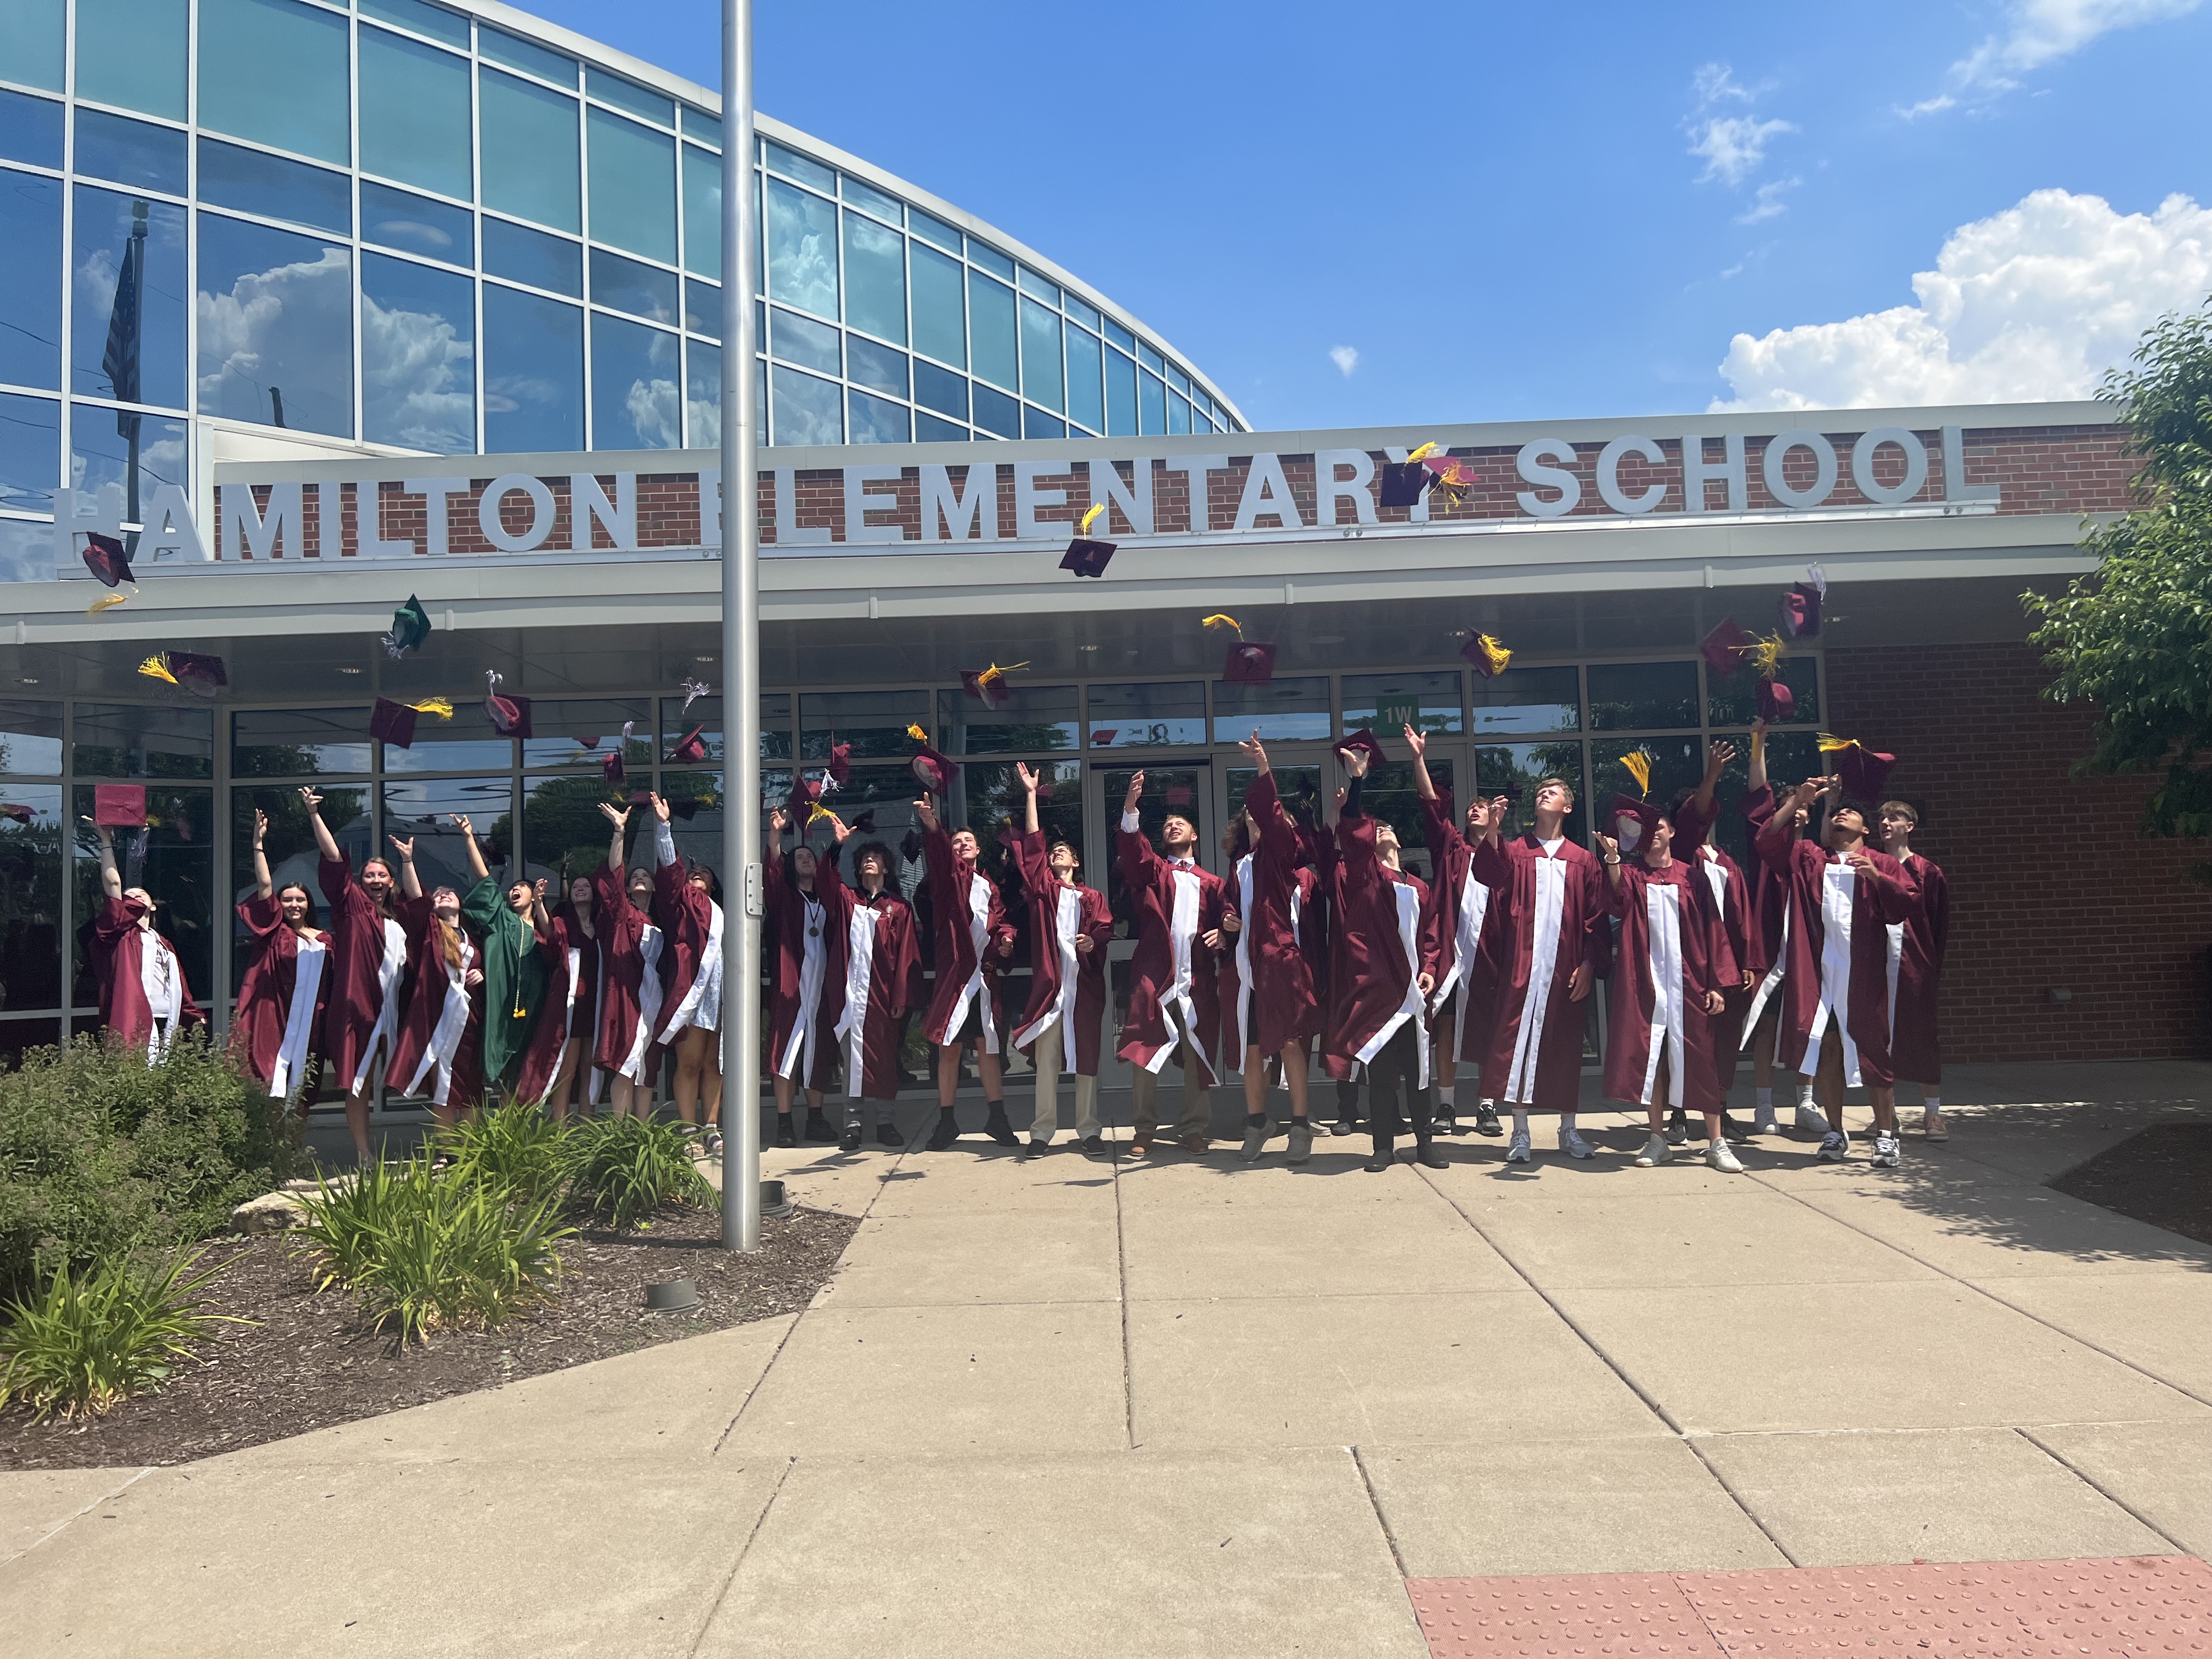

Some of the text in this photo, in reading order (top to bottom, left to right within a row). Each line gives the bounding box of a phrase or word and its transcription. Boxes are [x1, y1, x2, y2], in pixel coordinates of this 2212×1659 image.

[54, 471, 635, 563] HAMILTON
[1516, 425, 2001, 517] SCHOOL
[1384, 706, 1412, 724] 1W
